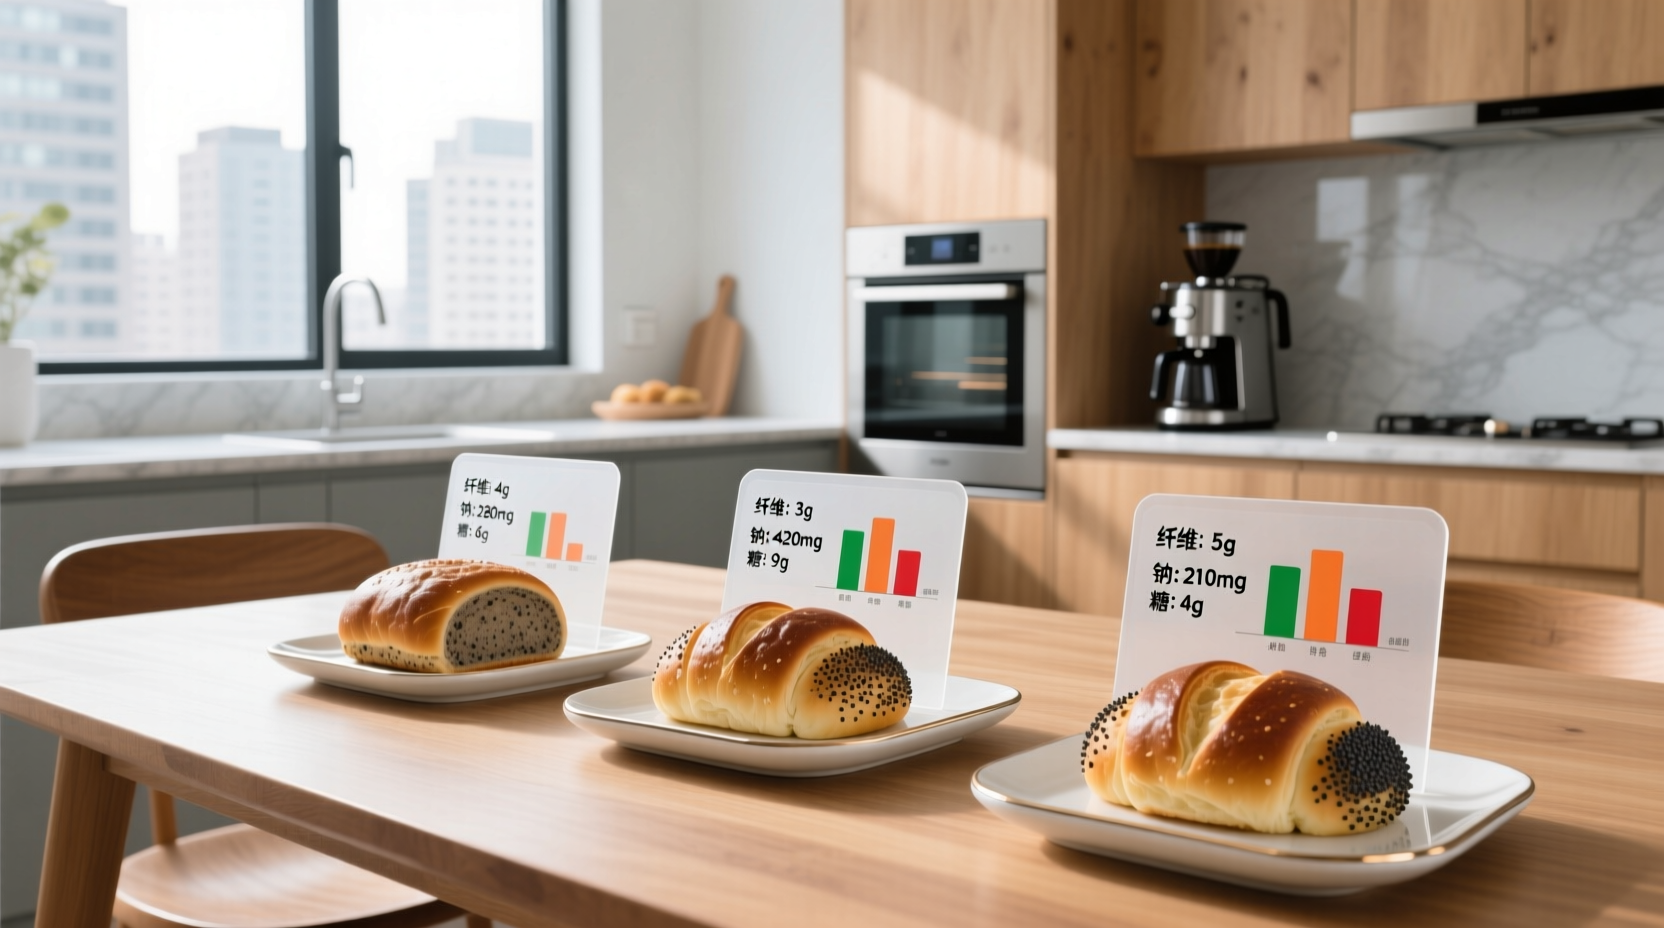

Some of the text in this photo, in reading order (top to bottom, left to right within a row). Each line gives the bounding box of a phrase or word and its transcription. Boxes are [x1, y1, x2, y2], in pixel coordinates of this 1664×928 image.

[753, 496, 814, 522] 纤维: 3g
[475, 525, 489, 544] 6g
[1155, 525, 1236, 557] 纤维: 5g
[770, 552, 790, 574] 9g
[1182, 566, 1247, 595] 210mg
[1179, 594, 1204, 618] 4g
